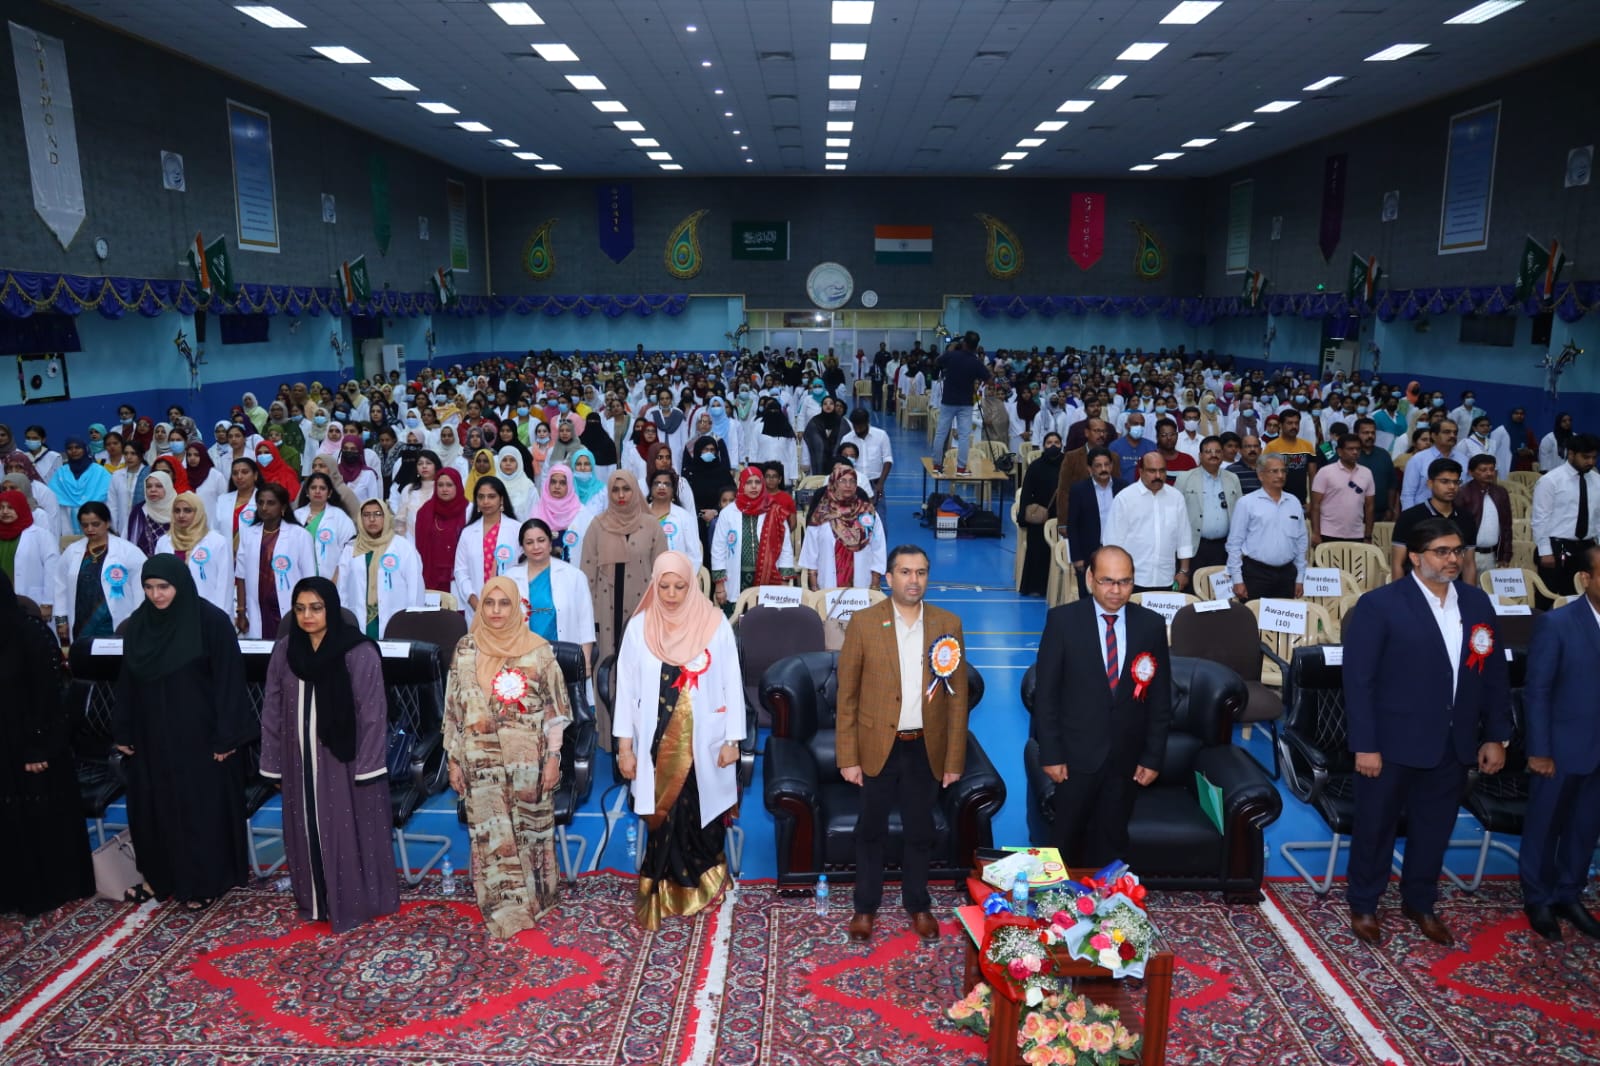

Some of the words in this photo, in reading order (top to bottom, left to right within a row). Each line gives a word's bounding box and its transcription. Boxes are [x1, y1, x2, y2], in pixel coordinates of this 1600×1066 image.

[32, 38, 59, 165] DIAMOND
[1306, 575, 1339, 583] Awardees
[764, 593, 800, 604] Awardees
[830, 598, 867, 606] Awardees
[1264, 605, 1304, 620] Awardees
[1275, 618, 1291, 628] (10)
